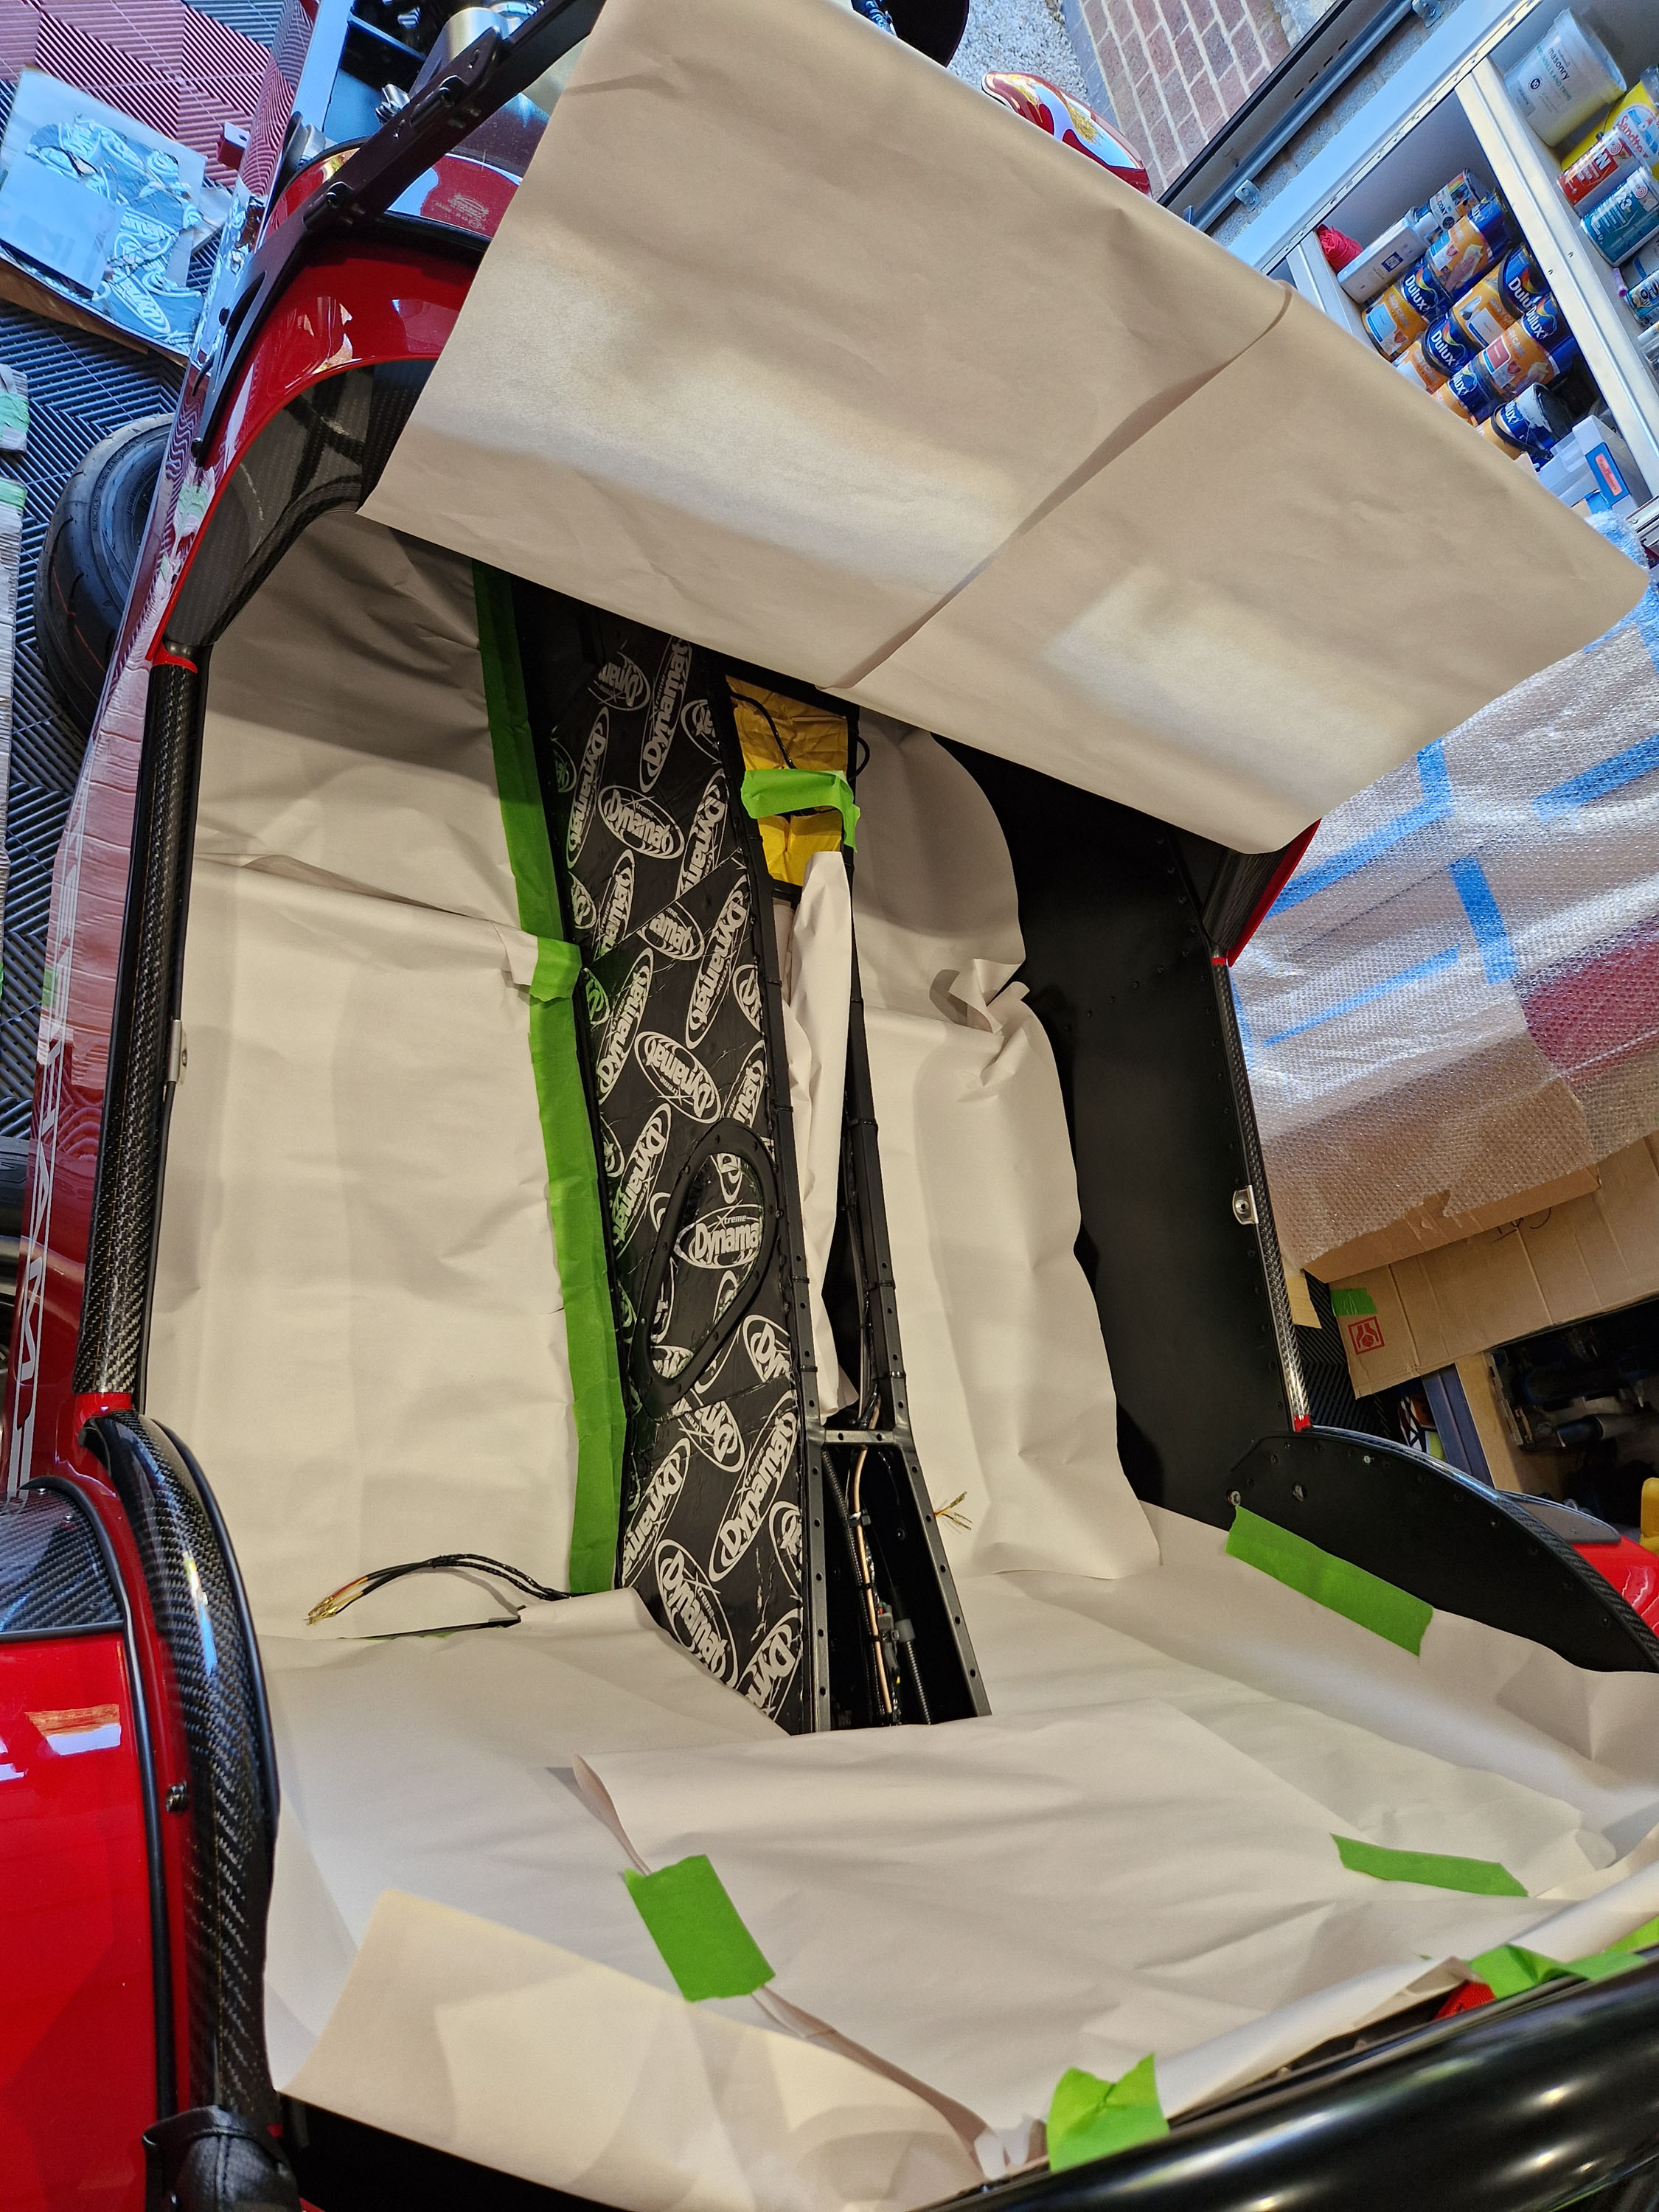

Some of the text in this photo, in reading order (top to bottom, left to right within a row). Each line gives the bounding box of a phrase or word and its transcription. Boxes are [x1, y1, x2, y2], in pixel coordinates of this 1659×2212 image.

[1548, 48, 1570, 81] masonry
[1405, 274, 1427, 311] Dulux
[1508, 276, 1531, 310] Dulu
[1526, 305, 1545, 339] Dulux
[1430, 330, 1456, 366] Dulux
[643, 641, 688, 766] Dynamat
[569, 732, 607, 849] Dynamat
[605, 789, 672, 854] Dynamat
[599, 872, 632, 957] namat
[692, 900, 746, 1026] Dynamat
[597, 968, 650, 1085] Dynamat
[644, 1038, 713, 1118] Dynamat
[615, 1125, 667, 1242] Dynamat
[695, 1221, 759, 1265] Dynama
[623, 1461, 684, 1578] Dynama
[719, 1416, 794, 1557] Dynamat
[662, 1549, 728, 1674] Dynamat
